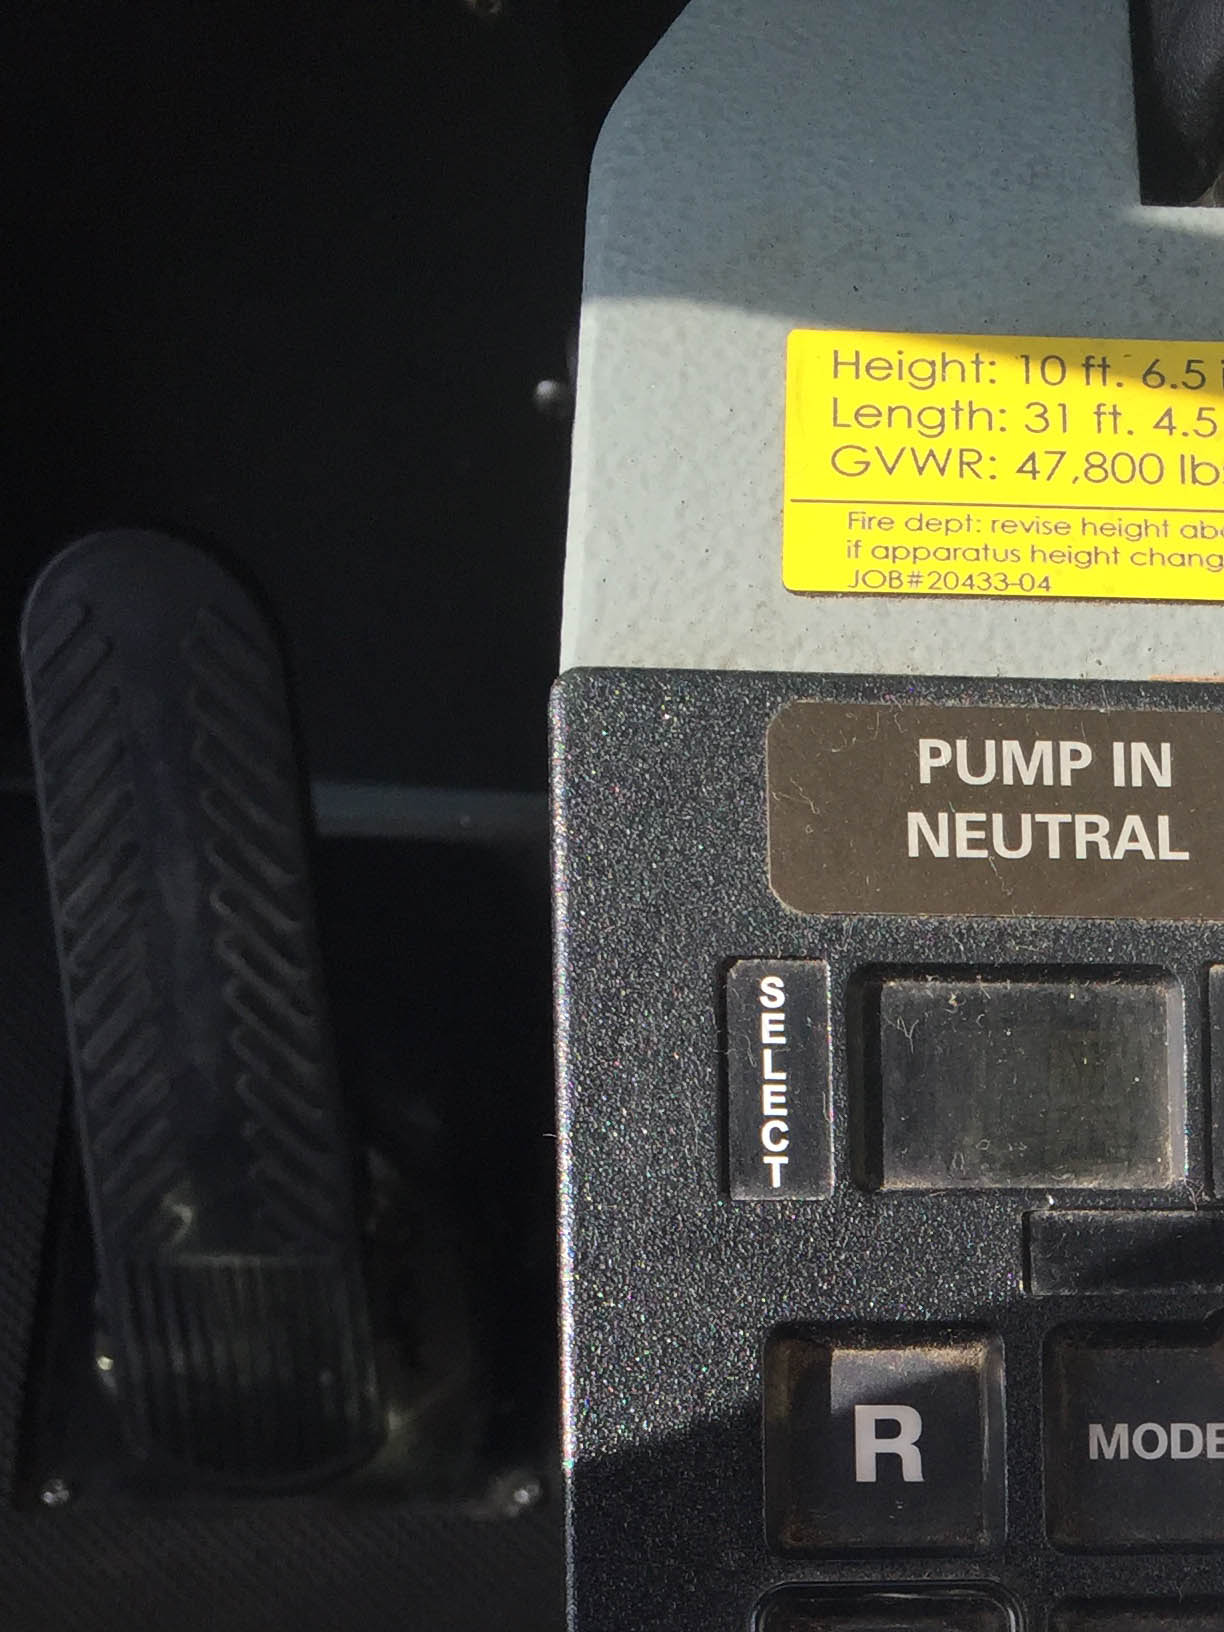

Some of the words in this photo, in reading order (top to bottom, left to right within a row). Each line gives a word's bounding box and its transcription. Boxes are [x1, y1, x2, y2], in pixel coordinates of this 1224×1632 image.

[831, 349, 997, 390] Height:
[1020, 354, 1067, 388] 10
[1081, 354, 1124, 389] ft.
[1141, 357, 1206, 391] 6.5
[831, 397, 1007, 438] Length:
[1024, 401, 1069, 434] 31
[1093, 402, 1134, 436] ft.
[1153, 406, 1217, 438] 4.5
[831, 445, 997, 481] GVWR:
[1015, 450, 1164, 486] 47,800
[848, 511, 895, 532] Fire
[904, 513, 982, 537] dept:
[990, 517, 1071, 537] revise
[1081, 518, 1173, 543] height
[846, 539, 860, 559] if
[870, 543, 1021, 569] apparatus
[1030, 546, 1120, 571] height
[848, 570, 1052, 593] JOB#20433-04
[918, 738, 1092, 787] PUMP
[1112, 742, 1172, 788] IN
[907, 811, 1190, 861] NEUTRAL
[759, 975, 790, 1188] SELECT
[854, 1404, 924, 1483] R
